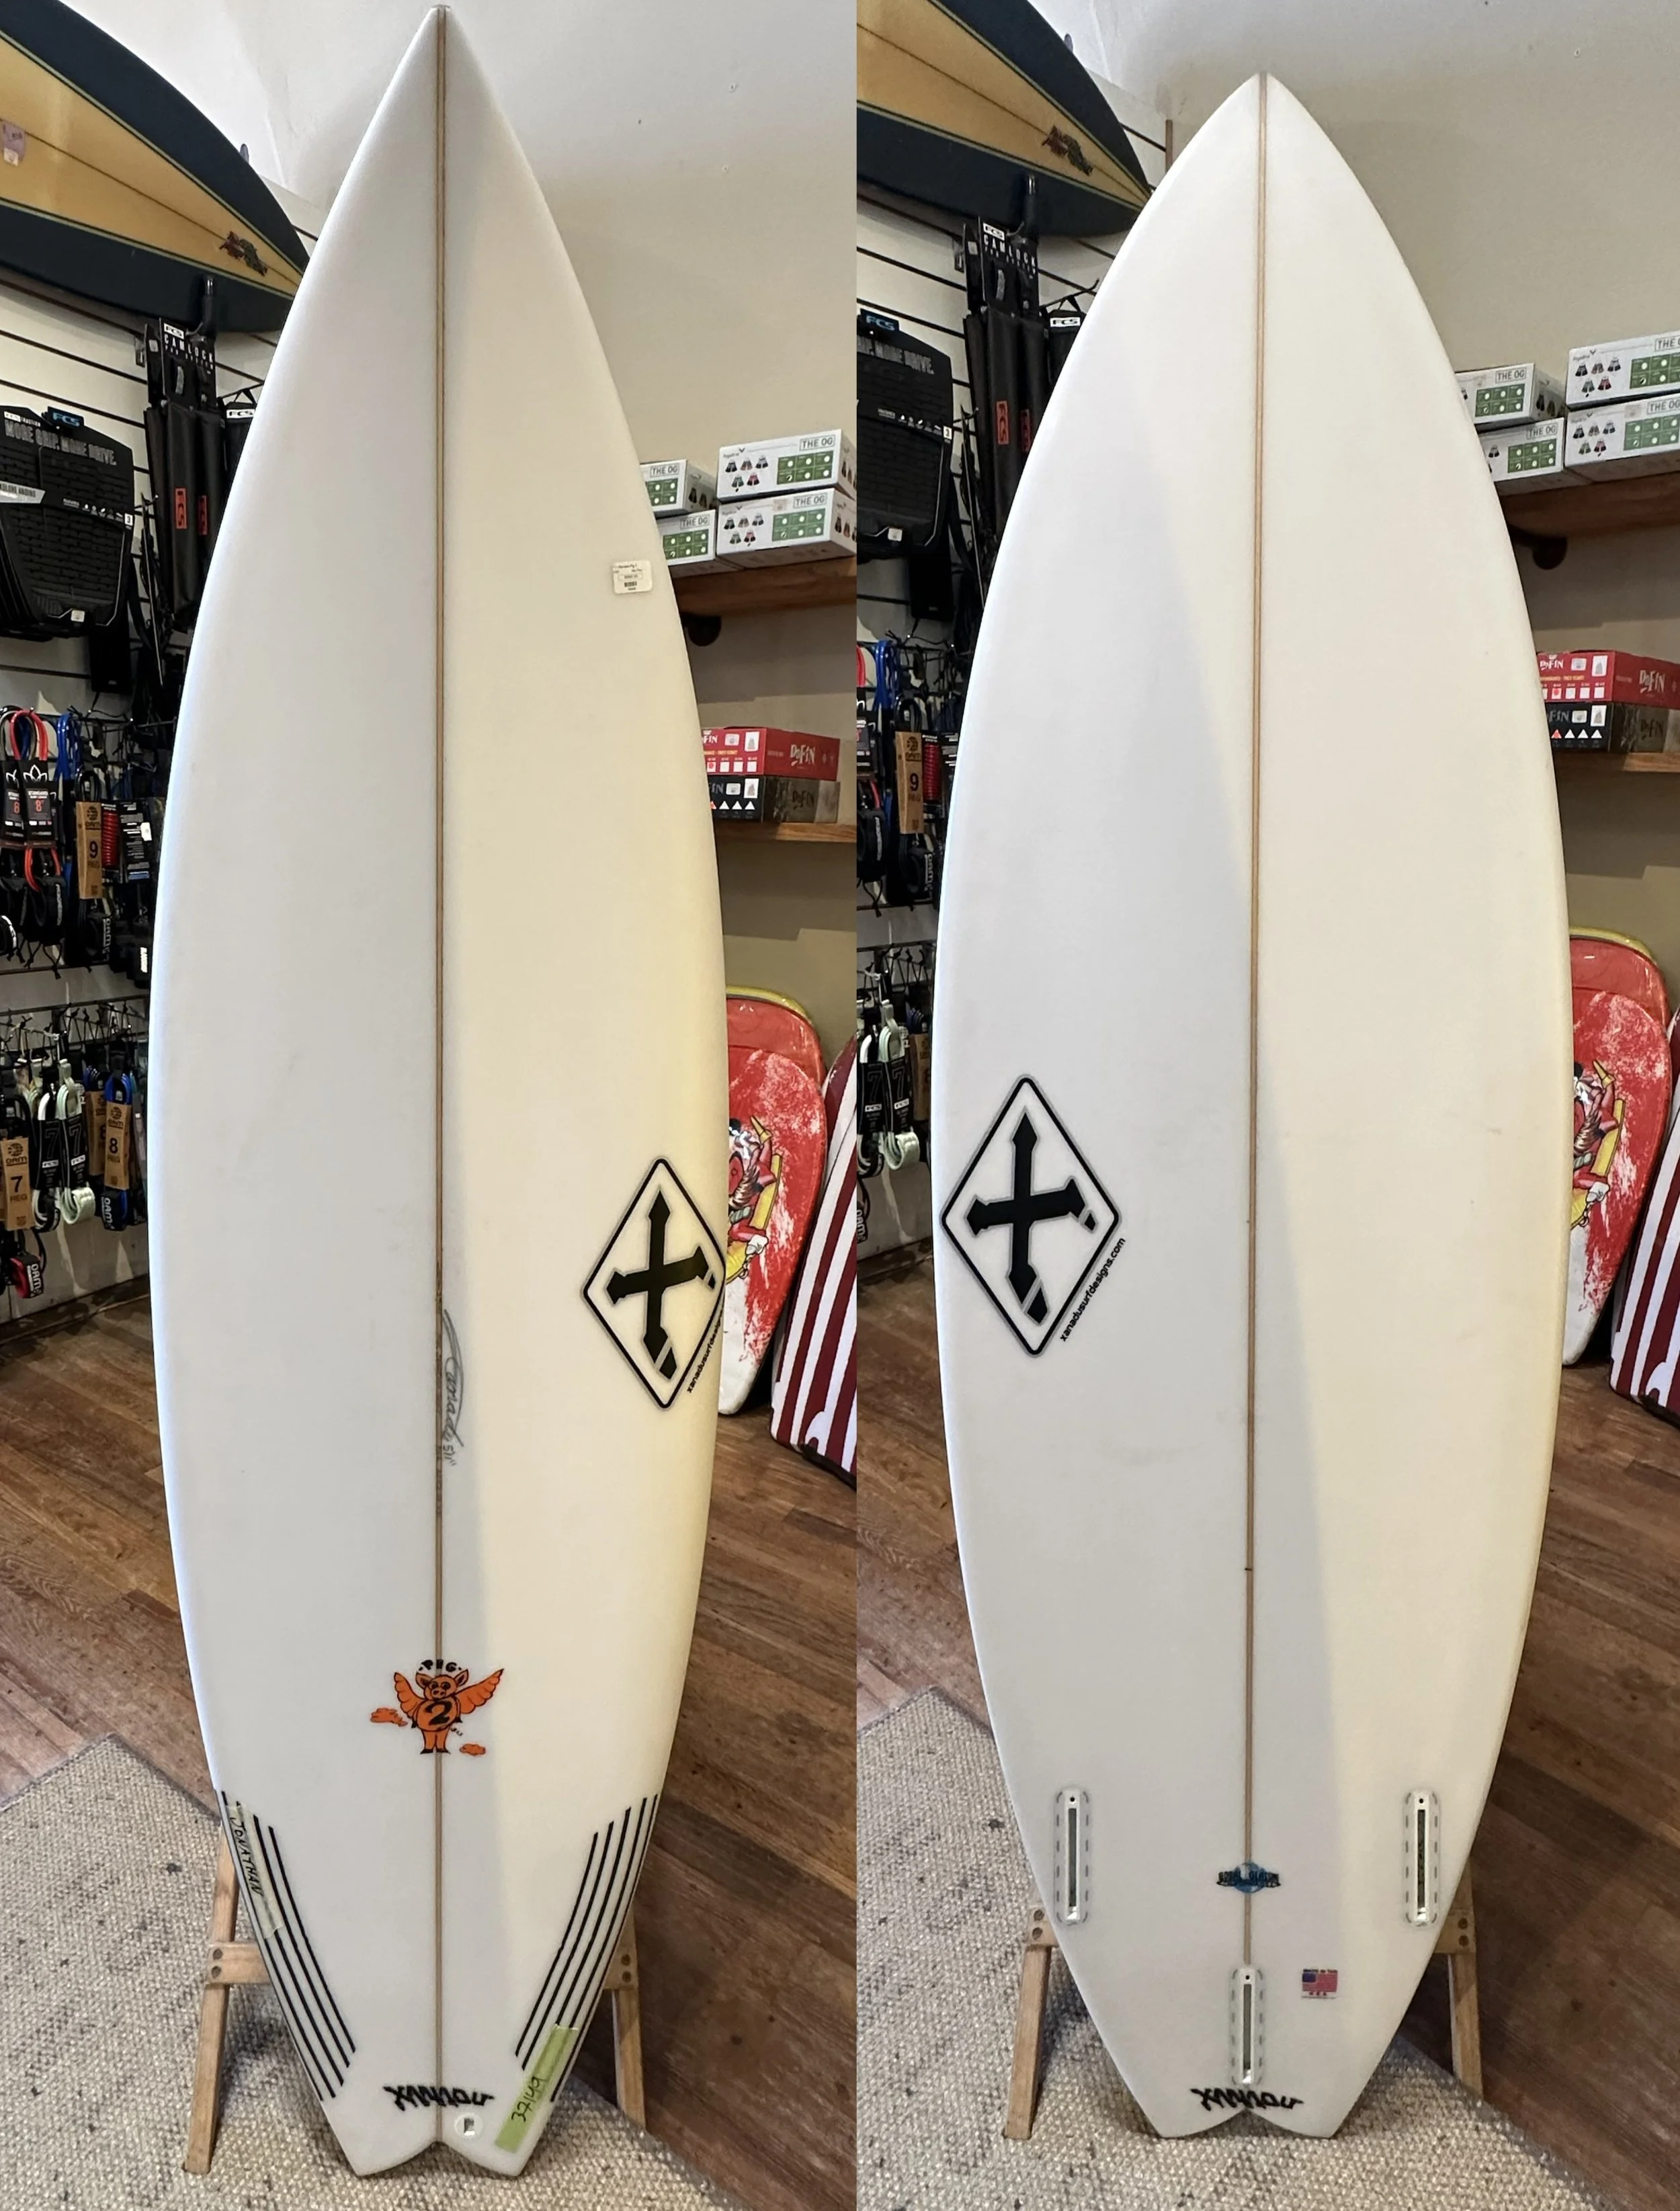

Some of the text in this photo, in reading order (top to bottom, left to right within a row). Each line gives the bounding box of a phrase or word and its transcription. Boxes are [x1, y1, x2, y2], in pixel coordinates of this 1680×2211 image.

[983, 234, 1036, 267] CAMLOCK
[866, 315, 895, 331] FCS
[164, 333, 213, 363] CAMLOCK
[1658, 339, 1675, 349] THE
[1497, 370, 1525, 381] THE OG
[1650, 401, 1665, 412] THE
[52, 412, 80, 427] FCS
[5, 419, 34, 443] MORE
[1529, 425, 1556, 437] THE OG
[802, 437, 833, 448] THE OG
[653, 465, 677, 475] THE OG
[176, 490, 185, 527] FCS
[796, 495, 825, 505] THE OG
[682, 516, 708, 527] THE OG
[910, 772, 919, 792] 9
[89, 841, 98, 858] 9
[892, 1066, 905, 1099] 7
[69, 1123, 81, 1156] 7
[110, 1137, 118, 1154] 8
[11, 1175, 22, 1192] 7
[1060, 1237, 1126, 1341] xanadusurfdesigns.com
[425, 1700, 452, 1726] 2
[229, 1817, 264, 1897] JONATHAN
[511, 2076, 546, 2122] 37149
